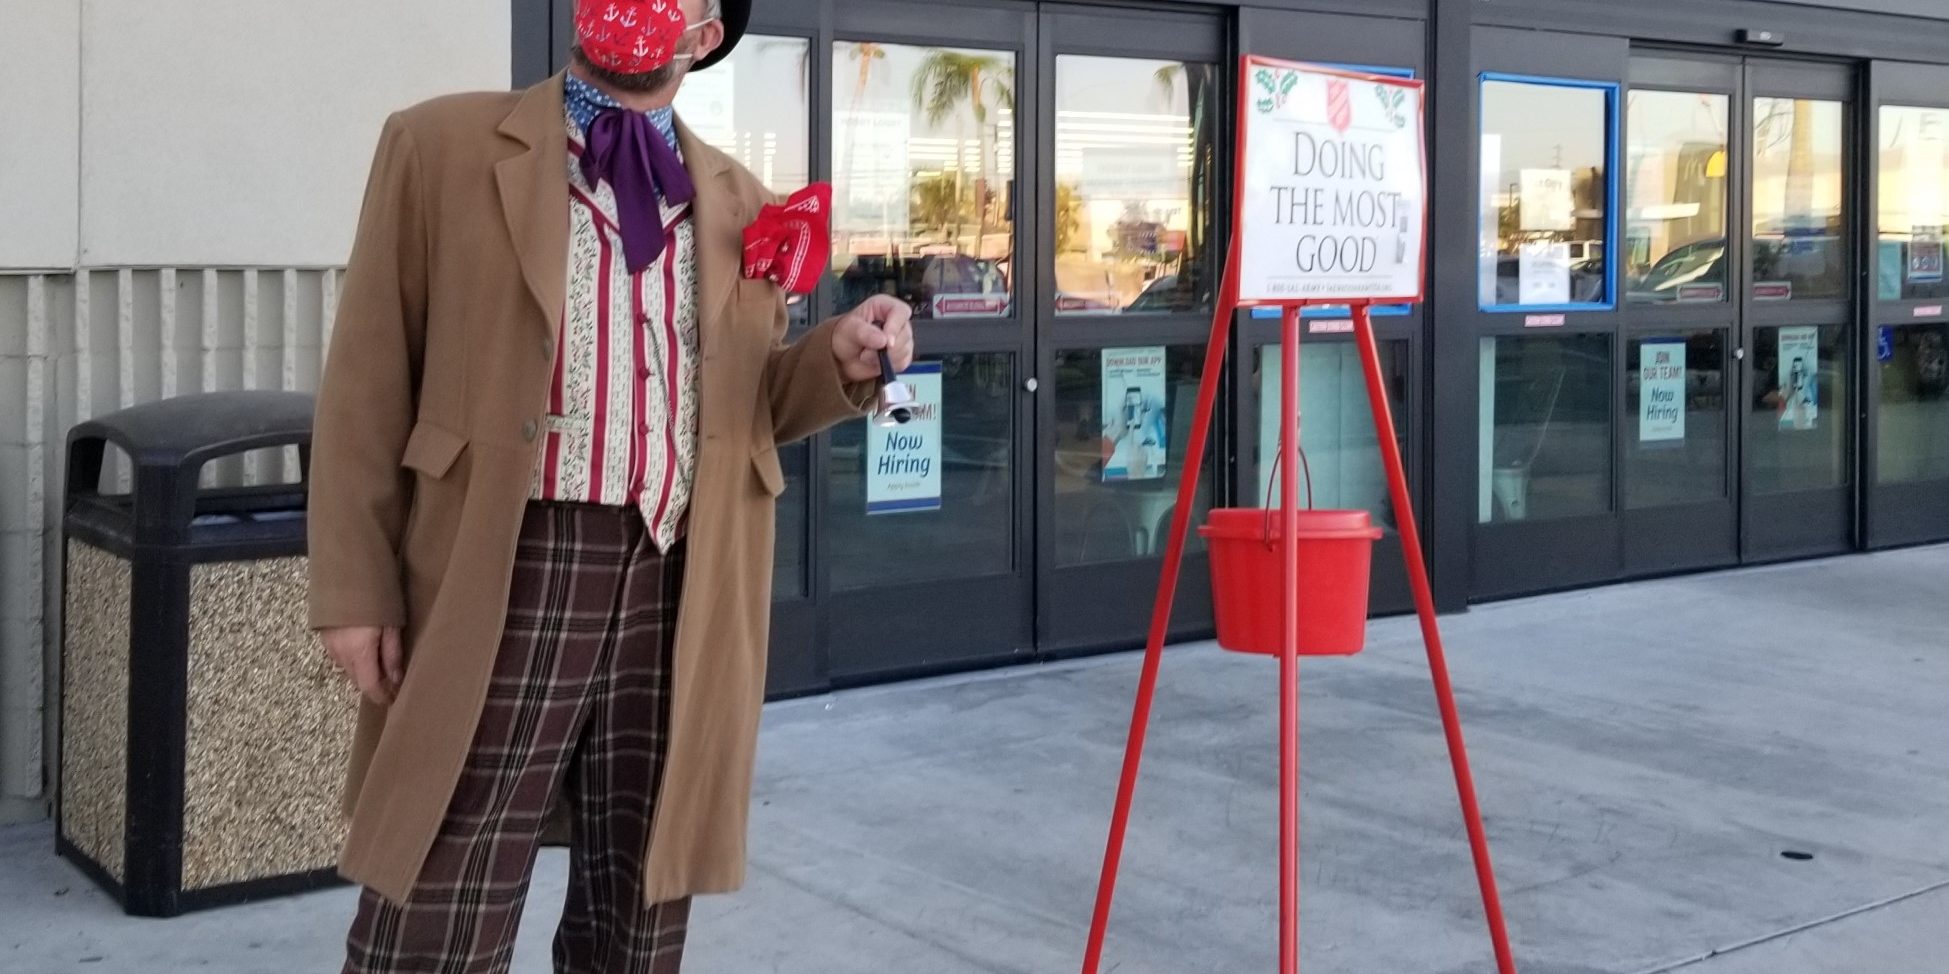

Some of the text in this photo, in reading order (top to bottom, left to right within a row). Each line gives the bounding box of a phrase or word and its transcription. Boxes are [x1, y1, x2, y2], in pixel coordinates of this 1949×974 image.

[1294, 132, 1384, 181] DOING
[1270, 186, 1401, 228] THE MOST
[1296, 234, 1377, 273] GOOD
[1651, 387, 1674, 403] Now
[1647, 405, 1678, 424] Hiring
[886, 431, 923, 452] Now
[877, 454, 931, 478] Hiring
